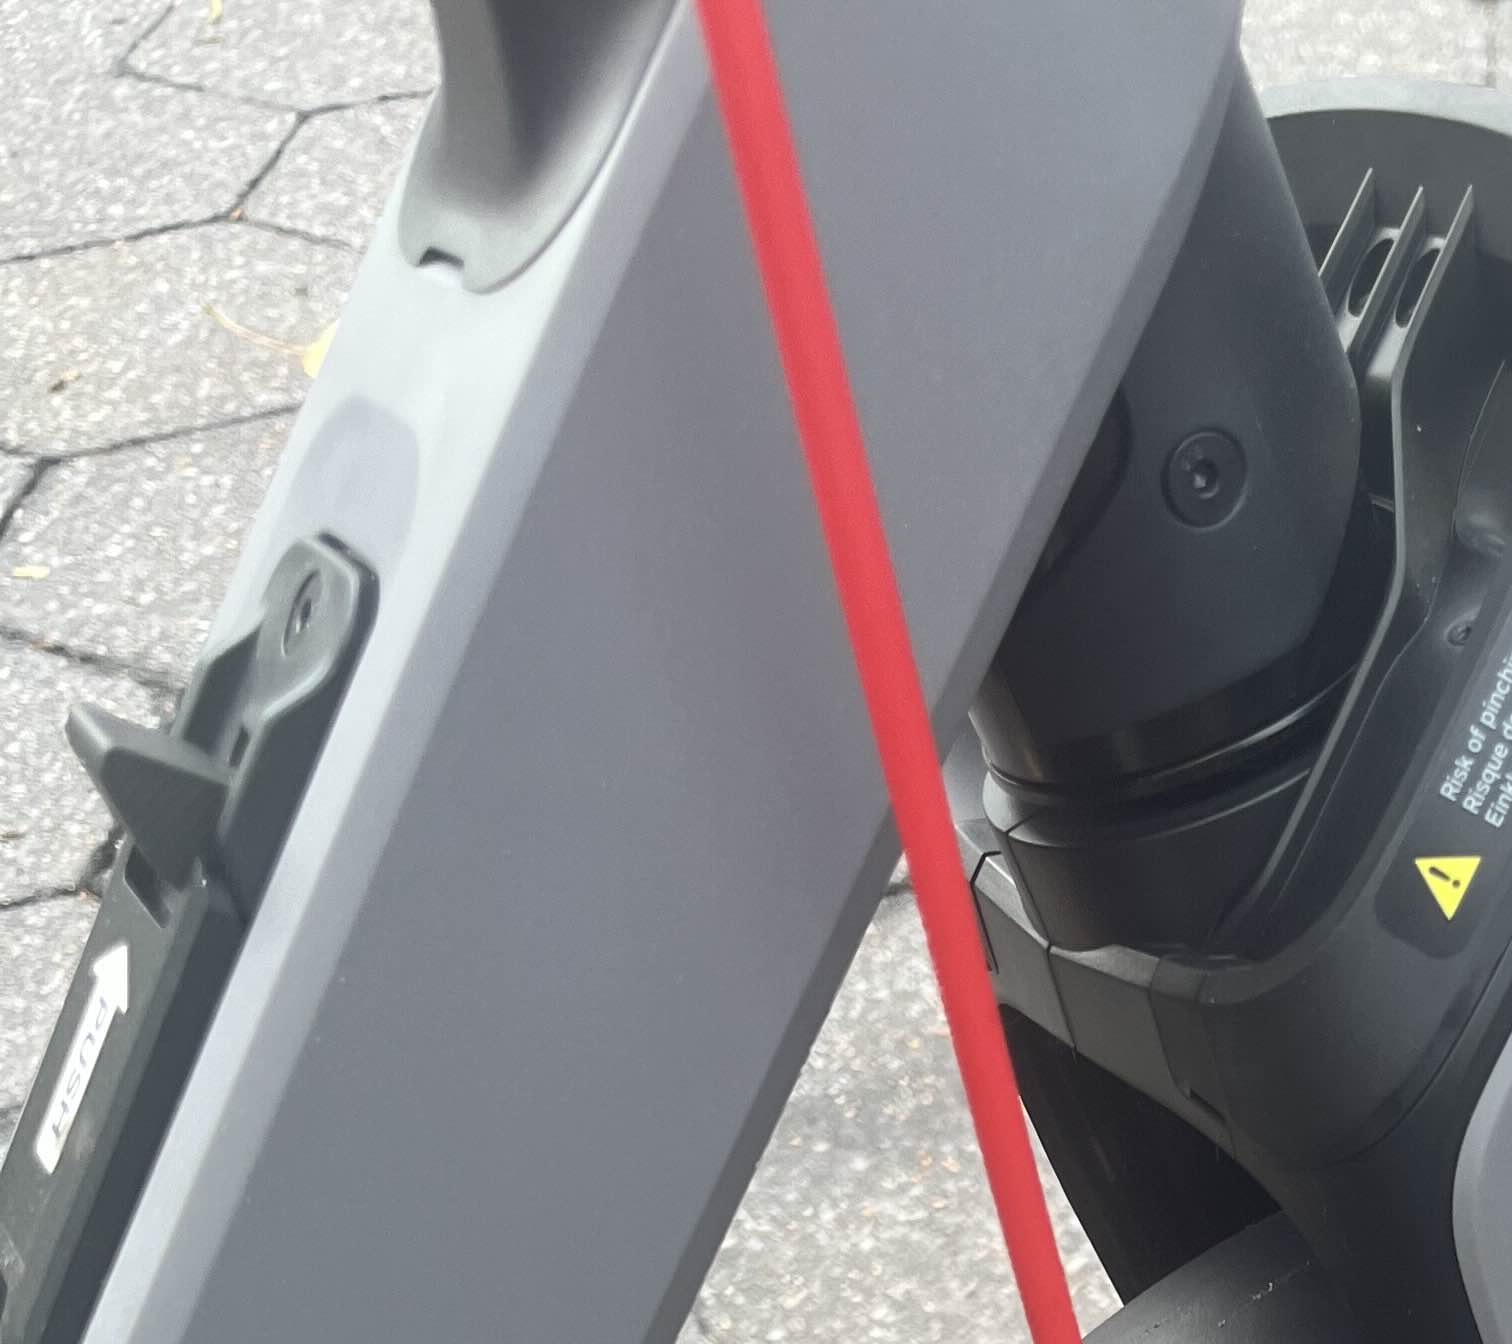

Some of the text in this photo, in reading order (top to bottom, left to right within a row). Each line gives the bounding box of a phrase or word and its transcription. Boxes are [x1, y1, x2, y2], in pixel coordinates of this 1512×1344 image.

[1439, 754, 1474, 802] Risk
[1467, 725, 1487, 753] of
[1462, 742, 1508, 815] Risque
[51, 995, 108, 1139] PUSH
